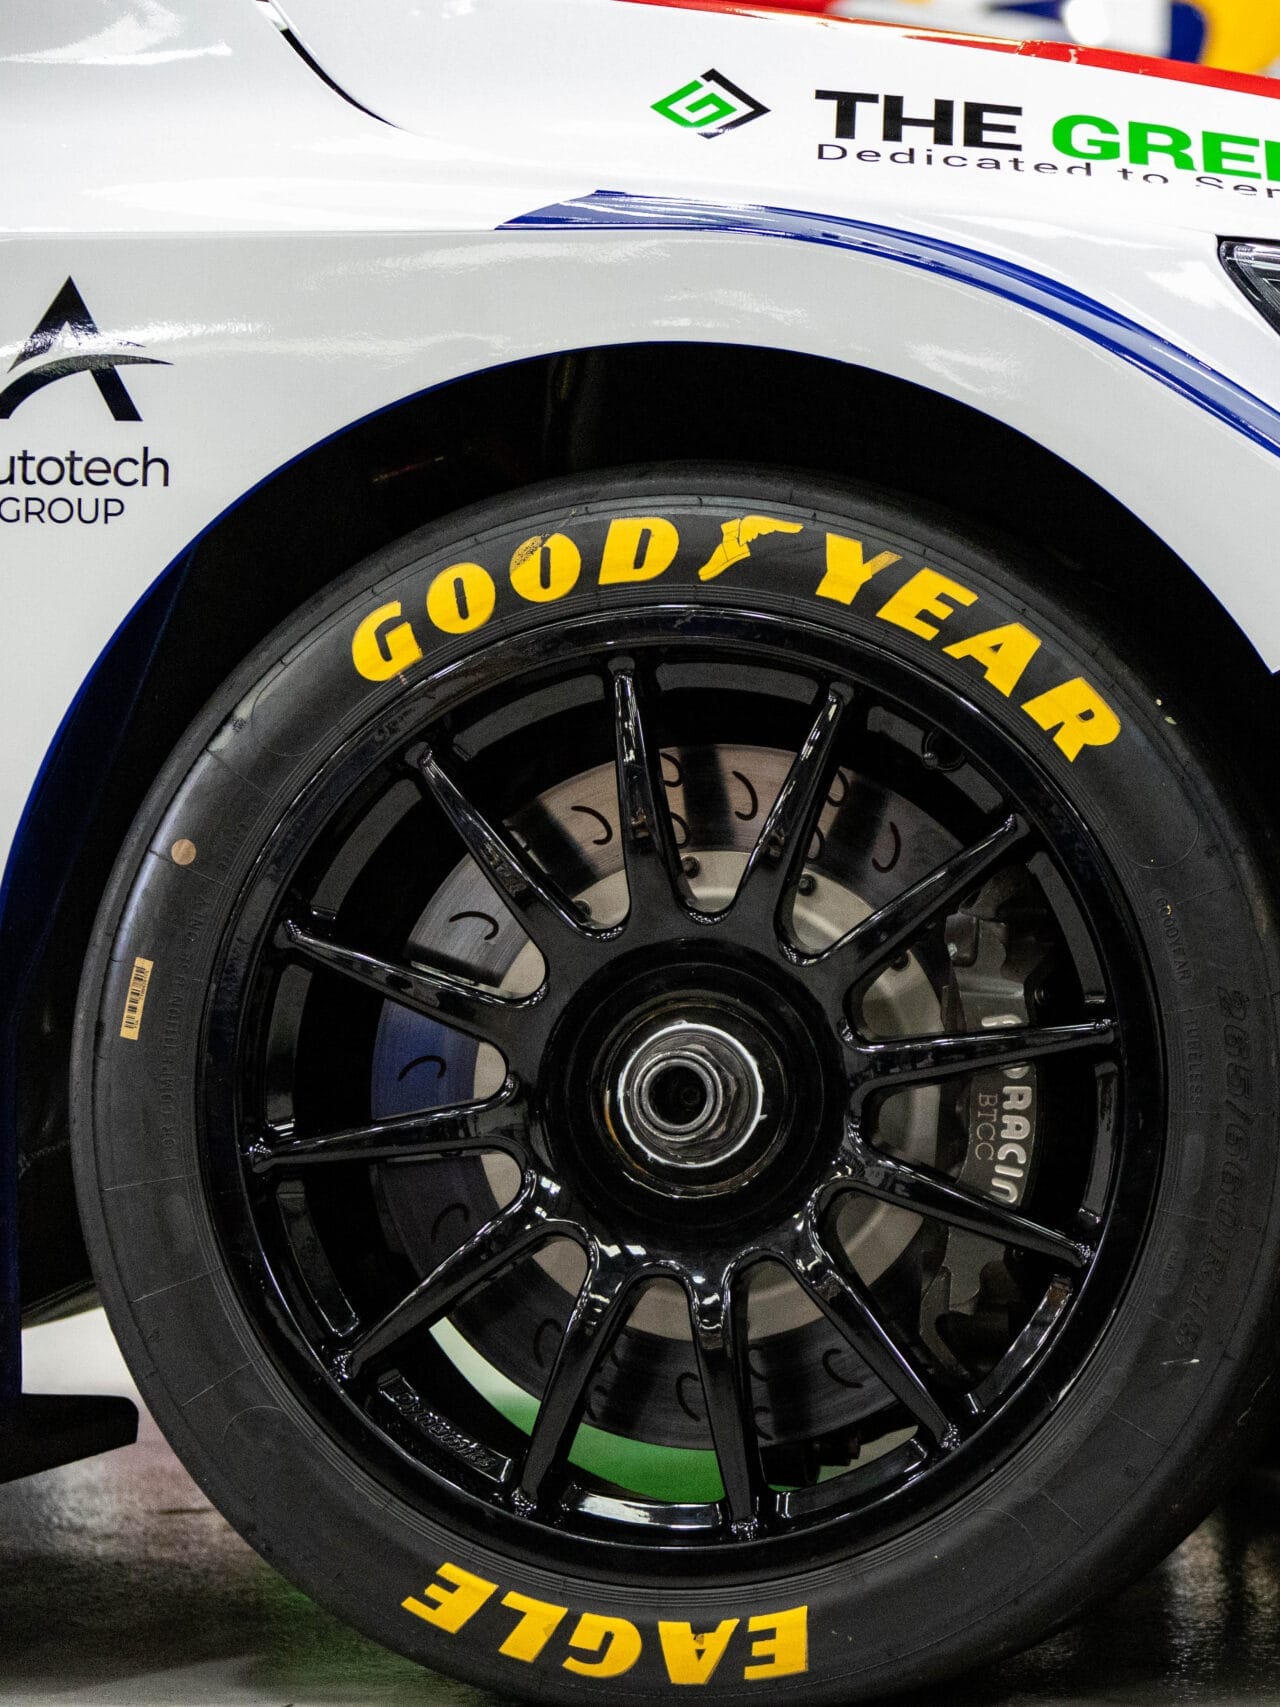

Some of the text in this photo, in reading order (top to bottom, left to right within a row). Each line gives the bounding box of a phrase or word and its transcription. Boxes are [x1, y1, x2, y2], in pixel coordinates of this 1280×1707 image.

[815, 89, 1023, 152] THE
[817, 143, 1092, 176] Dedicated
[1117, 167, 1169, 185] to
[0, 446, 169, 487] utotech
[0, 496, 125, 525] GROUP
[975, 1092, 998, 1161] BTCC
[991, 1085, 1033, 1203] RACIN
[401, 1562, 809, 1685] EAGLE
